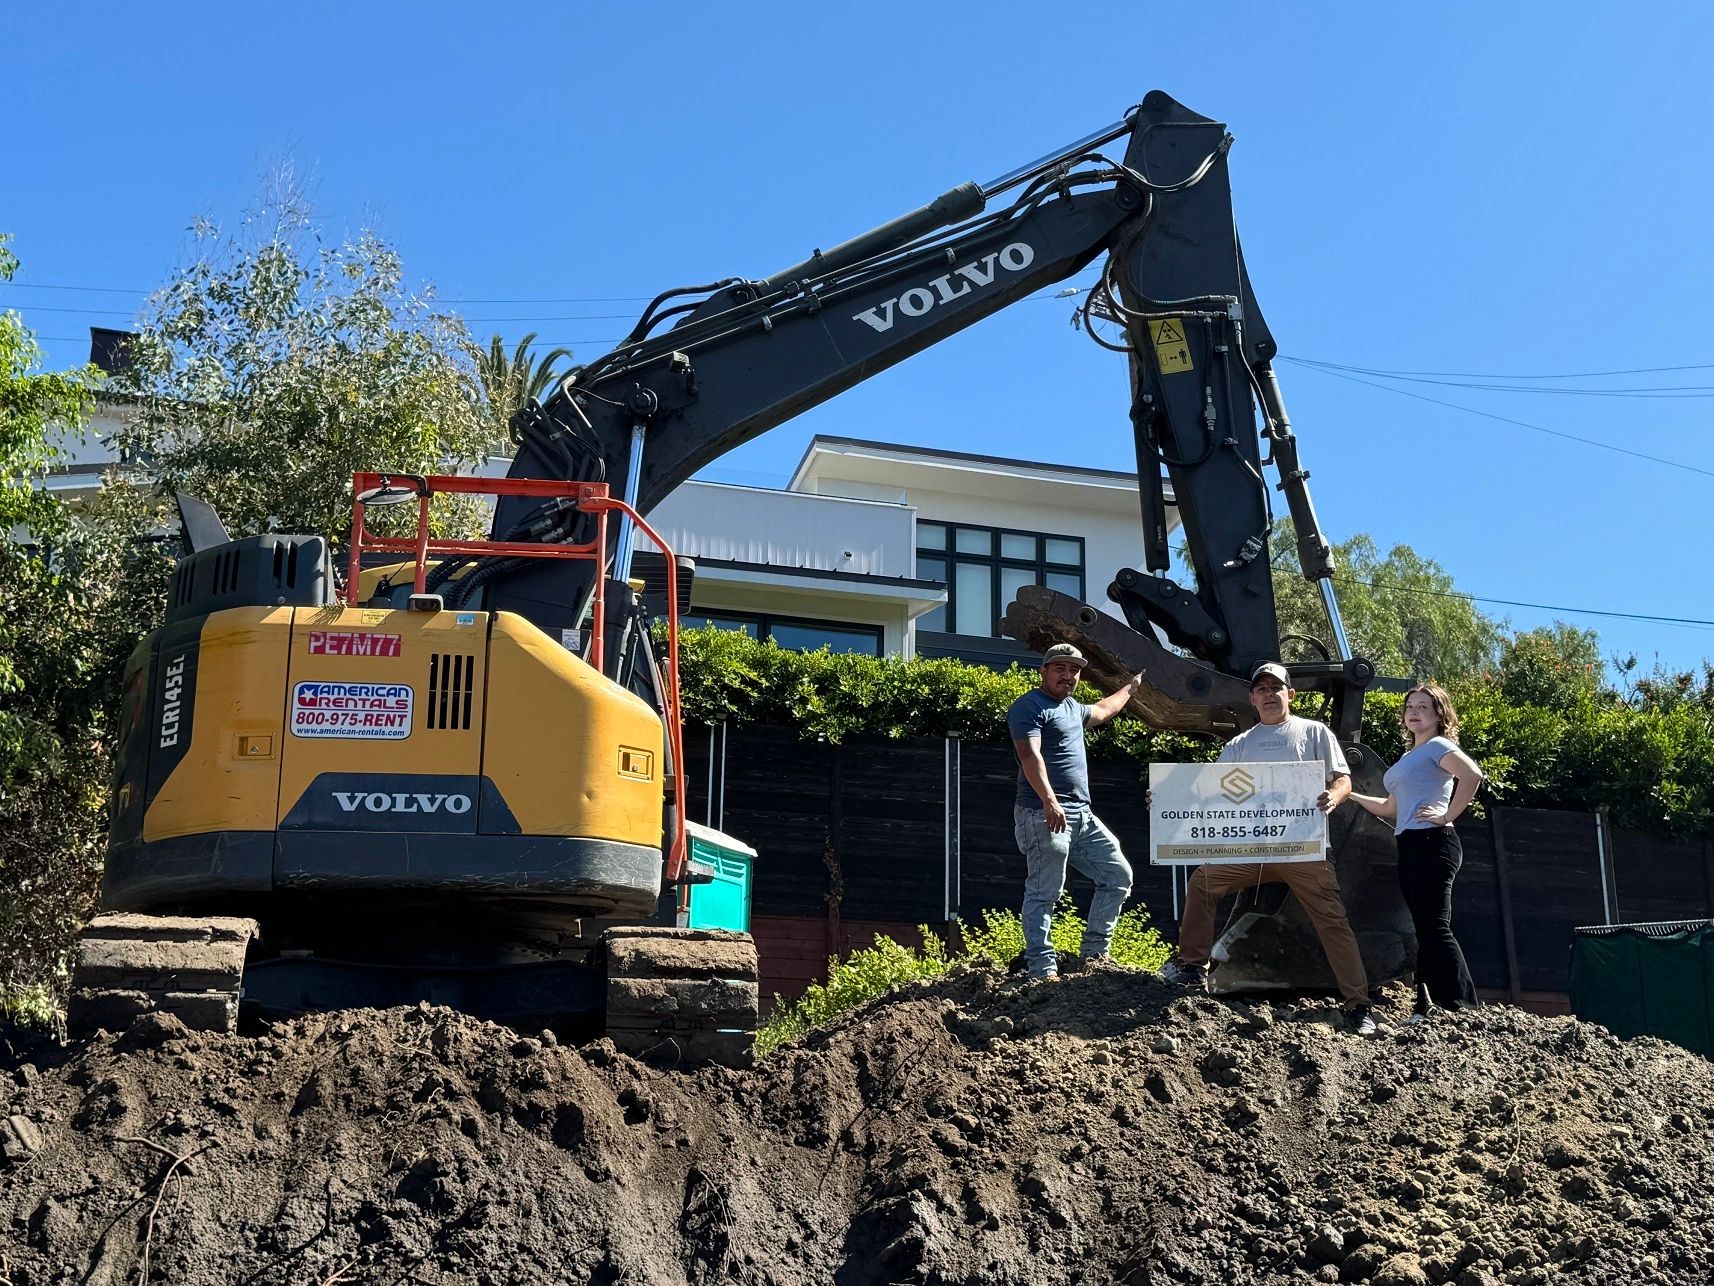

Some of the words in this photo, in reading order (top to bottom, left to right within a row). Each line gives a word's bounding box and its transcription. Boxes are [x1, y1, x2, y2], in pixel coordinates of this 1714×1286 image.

[852, 242, 1035, 333] VOLVO
[310, 632, 399, 656] PE7M77
[319, 684, 410, 698] AMERICAN
[318, 696, 408, 710] RENTALS
[295, 711, 408, 727] 800-975-RENT
[296, 727, 405, 737] www.american-rentals.com
[331, 792, 472, 814] VOLVO
[1161, 810, 1204, 820] GOLDEN
[1206, 810, 1237, 819] STATE
[1239, 808, 1316, 819] DEVELOPMENT
[1191, 825, 1287, 838] 818-855-6487
[1206, 847, 1243, 855] PLANNING
[1250, 845, 1305, 854] CONSTRUCTION
